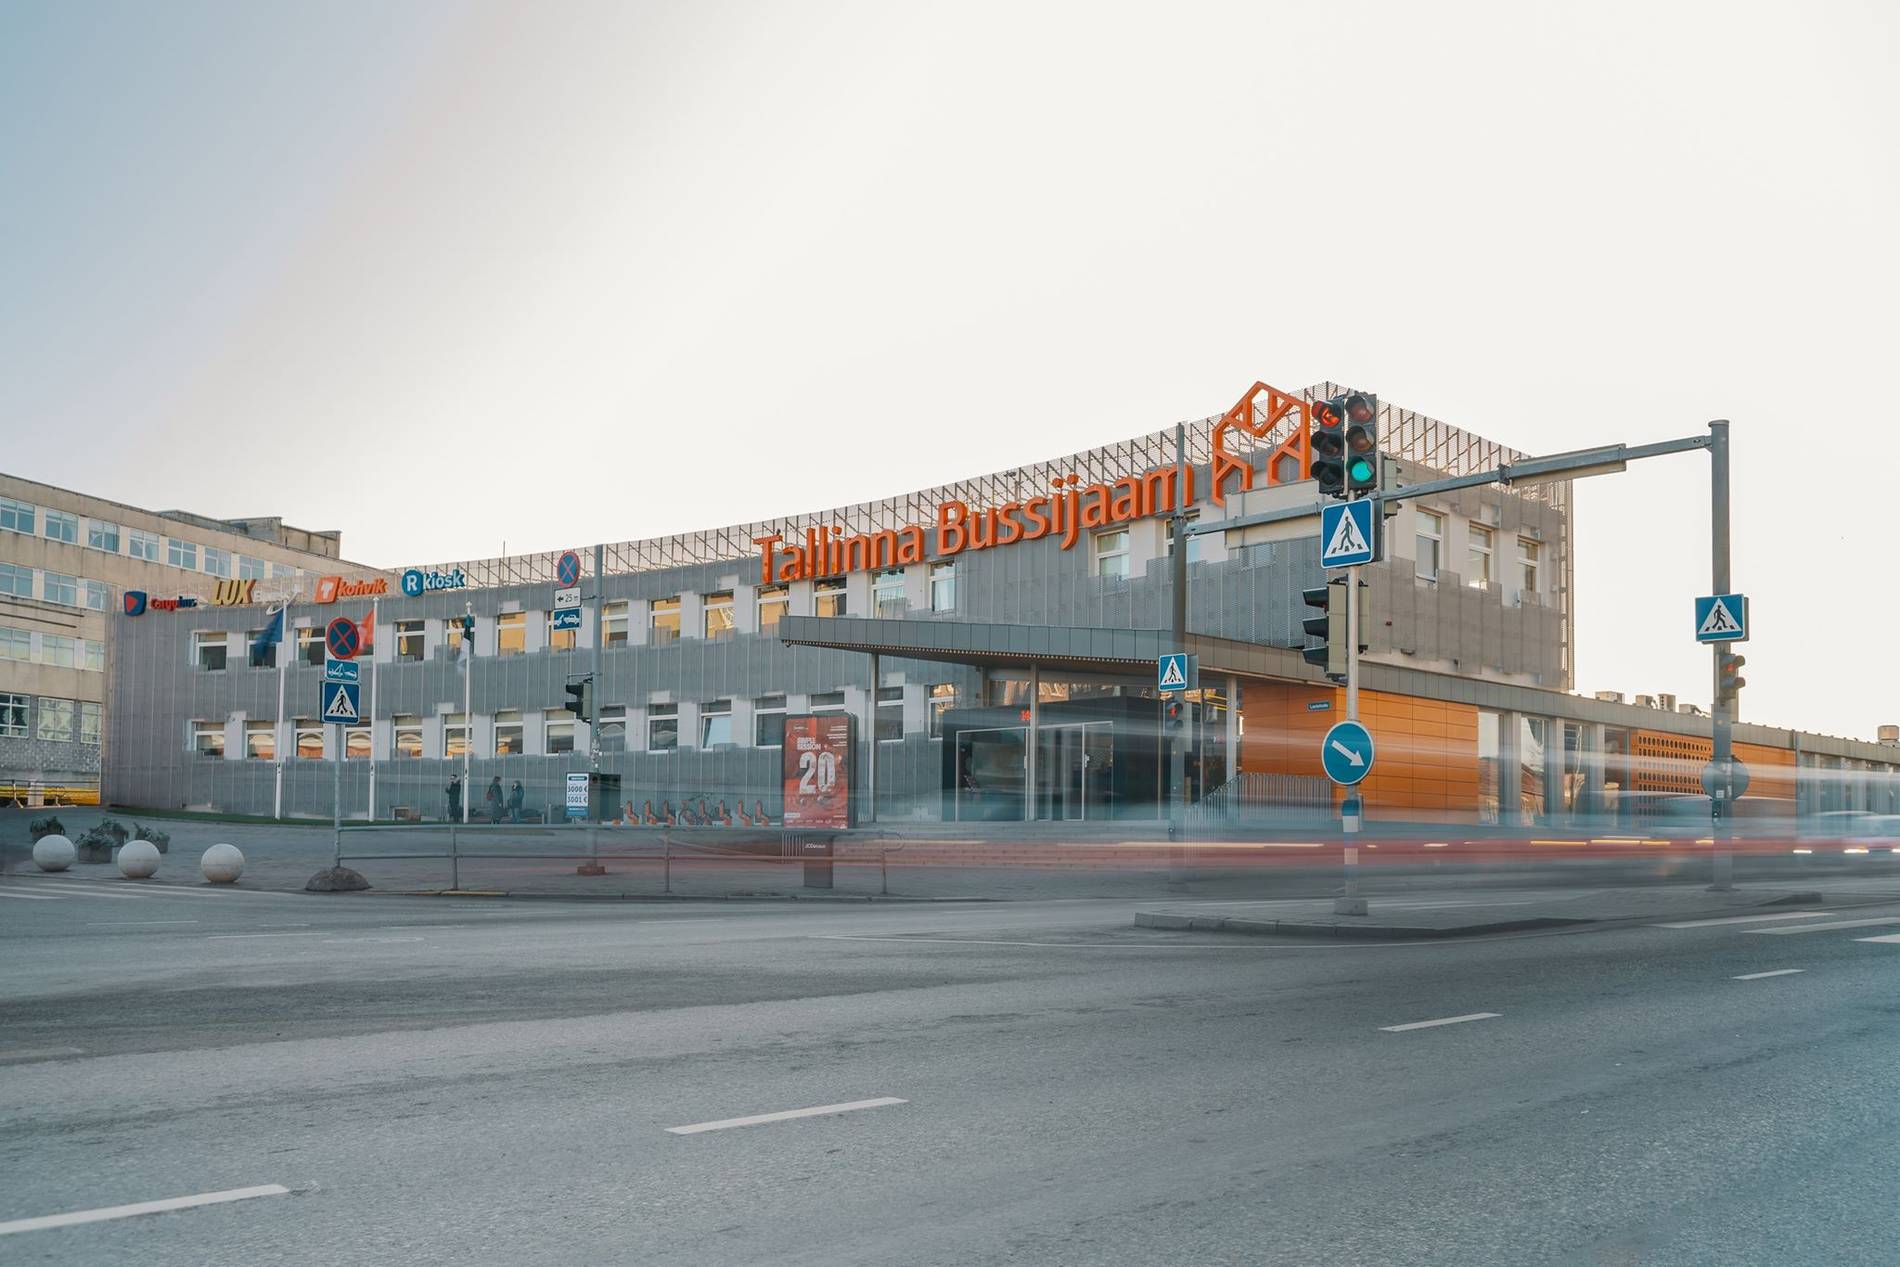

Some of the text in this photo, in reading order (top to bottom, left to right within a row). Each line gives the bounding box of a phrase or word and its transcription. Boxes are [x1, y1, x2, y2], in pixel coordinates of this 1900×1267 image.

[753, 463, 1195, 584] Tallinna Bussijaam
[210, 579, 257, 606] LUX
[406, 569, 465, 592] R kiosk
[799, 751, 836, 794] 20
